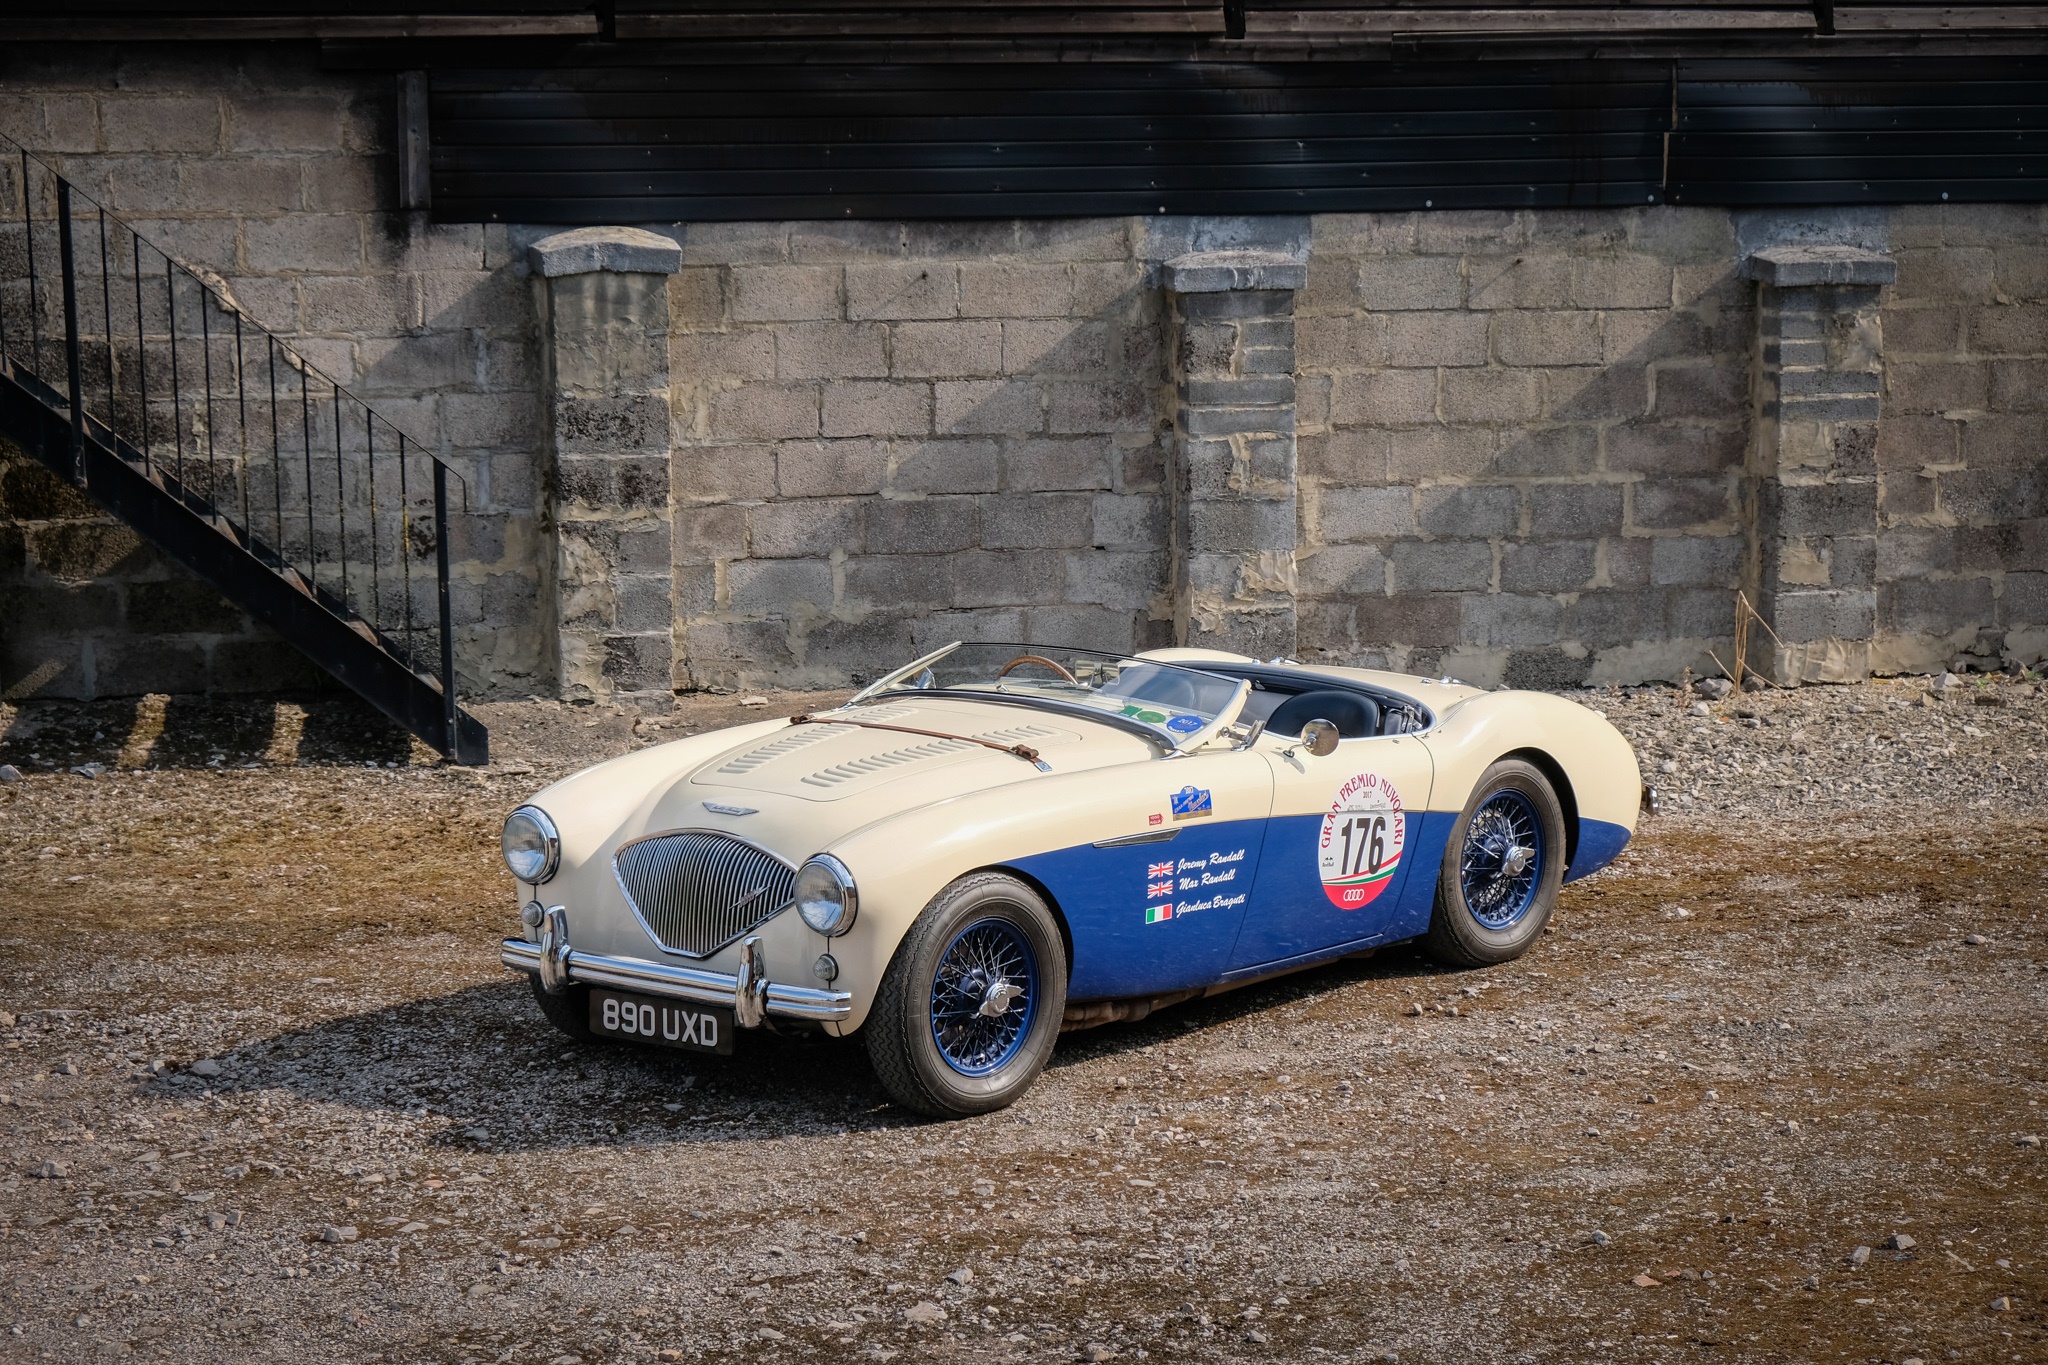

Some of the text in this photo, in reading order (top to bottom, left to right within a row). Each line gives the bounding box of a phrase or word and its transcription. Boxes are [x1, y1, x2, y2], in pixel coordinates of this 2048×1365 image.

[1362, 790, 1372, 799] 2017
[1321, 773, 1403, 849] GRAN PREMIO NUVOLARI
[1341, 816, 1386, 875] 176
[1176, 849, 1245, 875] Jeremy Randall
[1179, 868, 1236, 890] Max Randall
[1176, 900, 1212, 918] Gianluca
[602, 998, 718, 1047] 890 UXD
